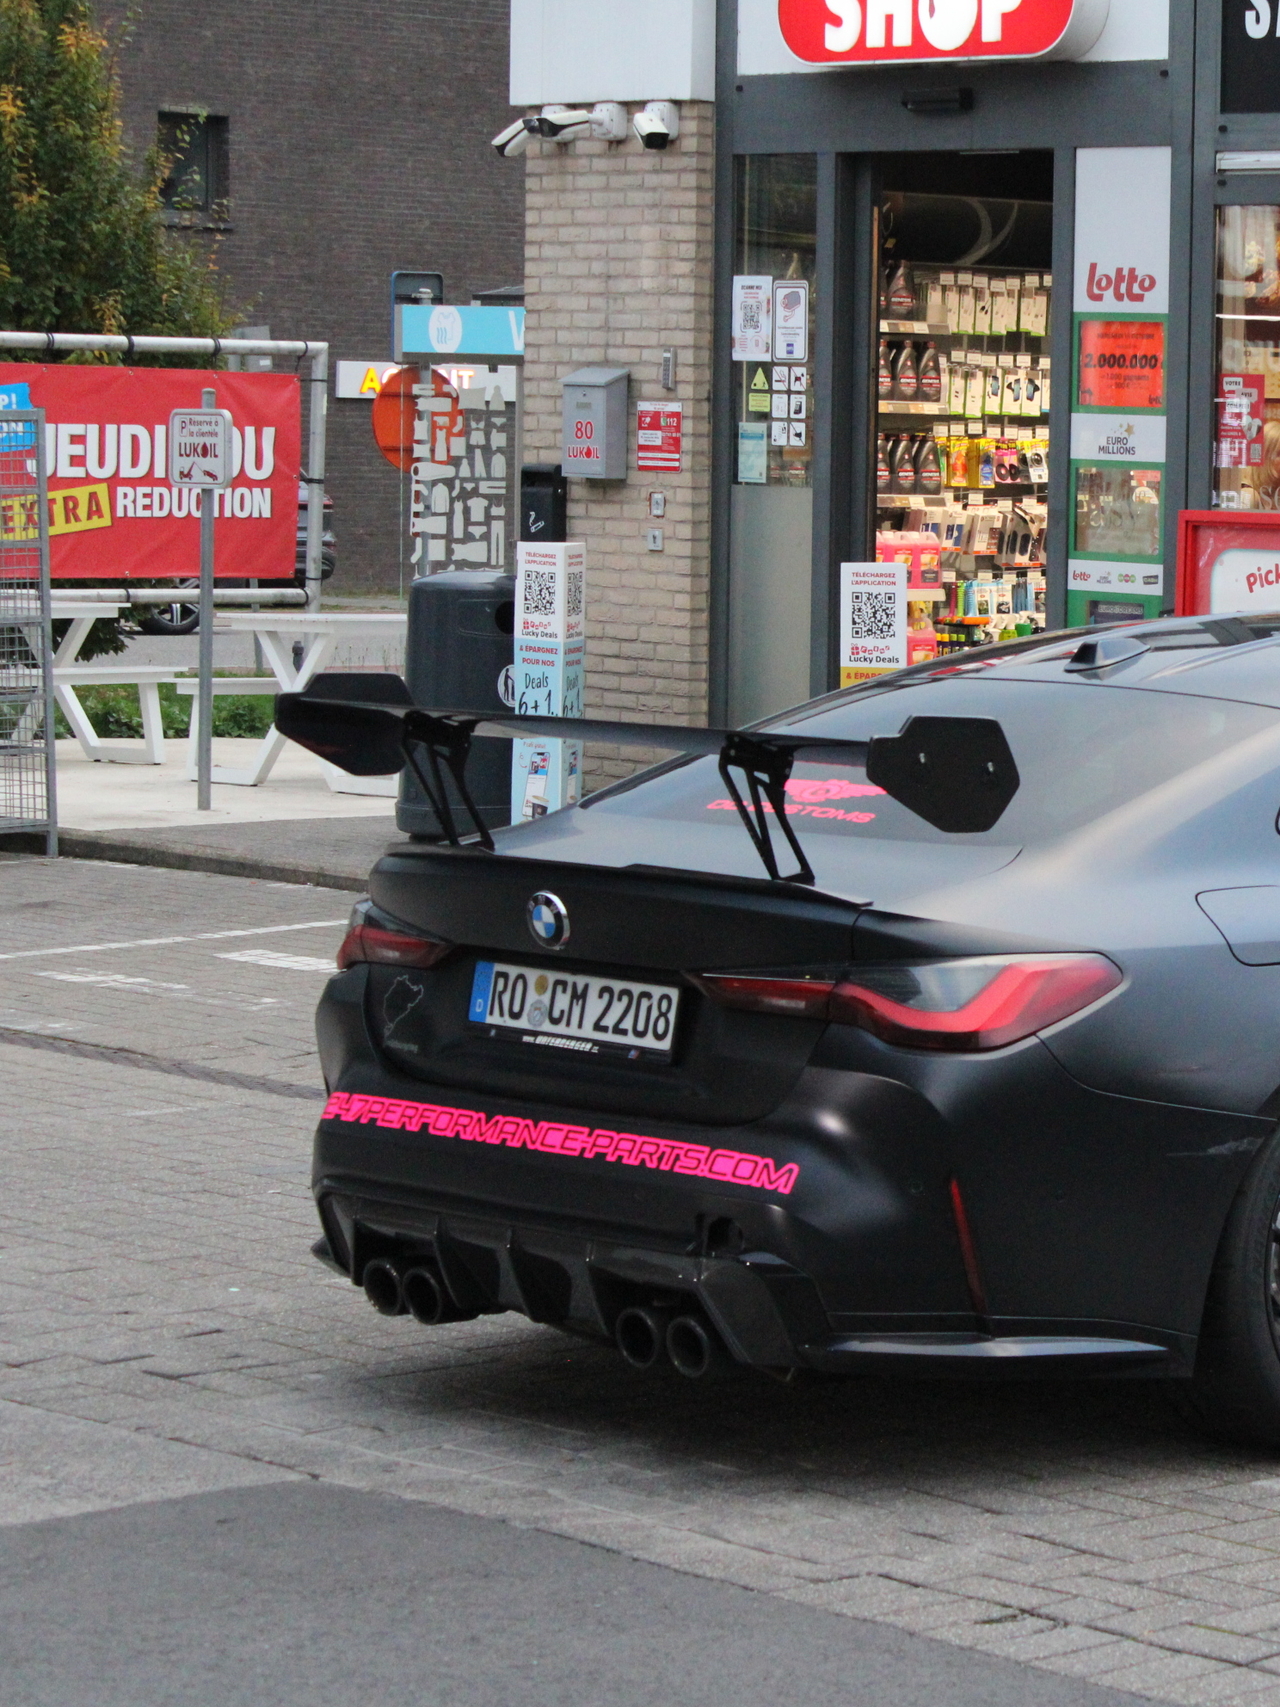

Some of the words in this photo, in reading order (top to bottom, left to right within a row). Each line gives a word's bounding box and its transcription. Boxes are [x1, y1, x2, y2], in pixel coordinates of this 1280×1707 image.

[824, 0, 1022, 52] SHOP
[667, 417, 677, 426] 112
[574, 420, 594, 440] 80
[1106, 436, 1129, 446] EURO
[1098, 445, 1136, 456] MILLIONS
[852, 571, 896, 579] TÉLÉCHARGEZ
[522, 629, 539, 638] Lucky
[541, 631, 558, 639] Deals
[849, 655, 873, 664] Lucky
[875, 655, 900, 664] Deals
[525, 671, 549, 689] Deals
[489, 971, 528, 1020] RO
[548, 979, 589, 1029] CM
[593, 986, 673, 1041] 2208
